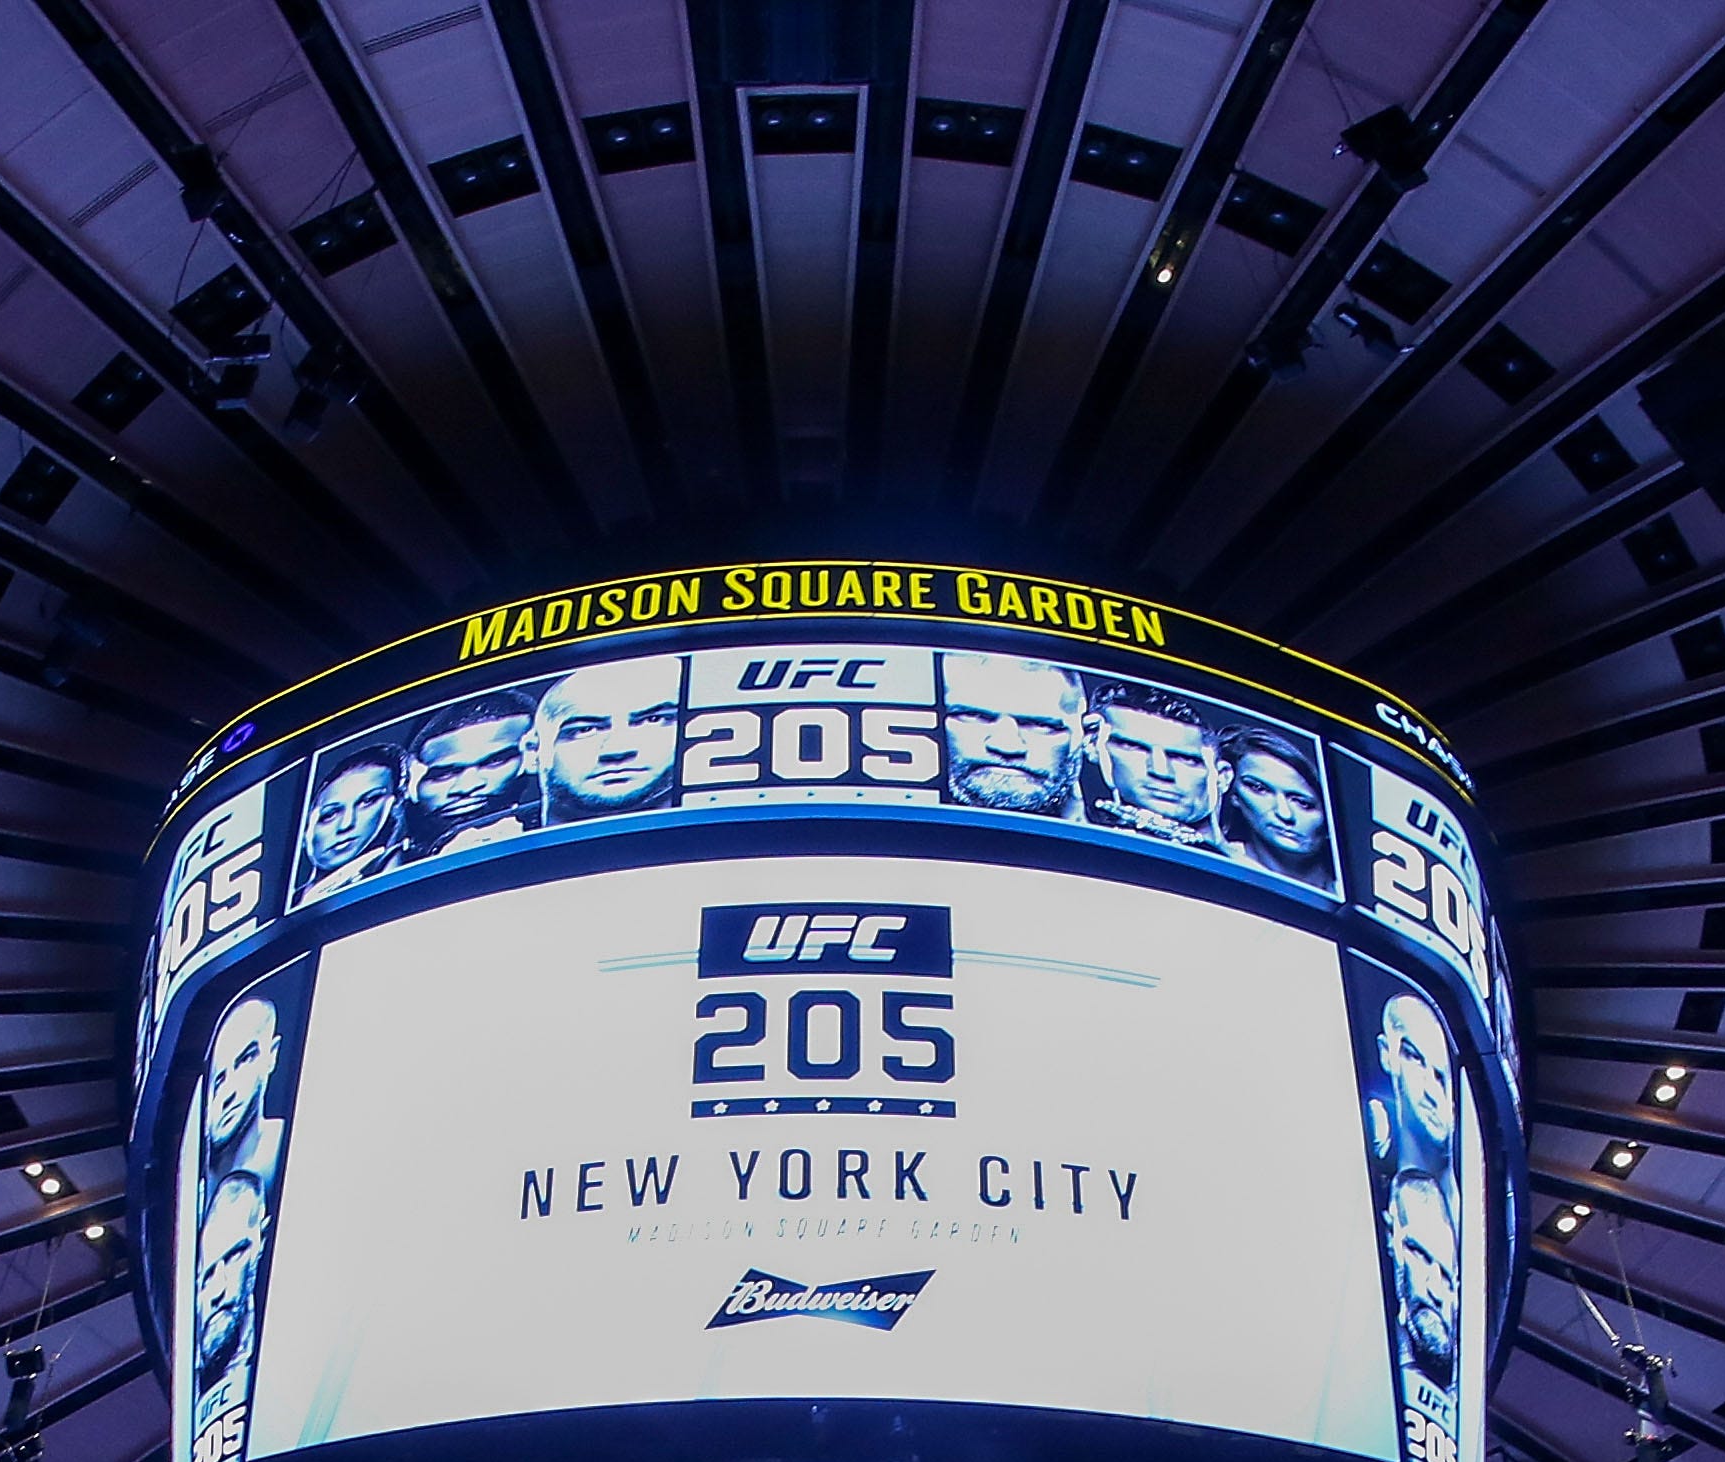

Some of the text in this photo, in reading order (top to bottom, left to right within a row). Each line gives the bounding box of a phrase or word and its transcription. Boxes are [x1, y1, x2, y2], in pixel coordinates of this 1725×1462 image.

[460, 567, 1165, 660] MADISON SQUARE GARDEN
[738, 659, 885, 690] UFC
[683, 707, 941, 787] 205
[1375, 702, 1478, 792] CHAS
[744, 916, 906, 959] UFC
[693, 990, 955, 1084] 205
[521, 1149, 1140, 1223] NEW YORK CITY
[626, 1218, 1022, 1244] MADISON SQUARE GARDEN
[726, 1279, 915, 1315] Budweiser
[1418, 1386, 1451, 1424] UFC
